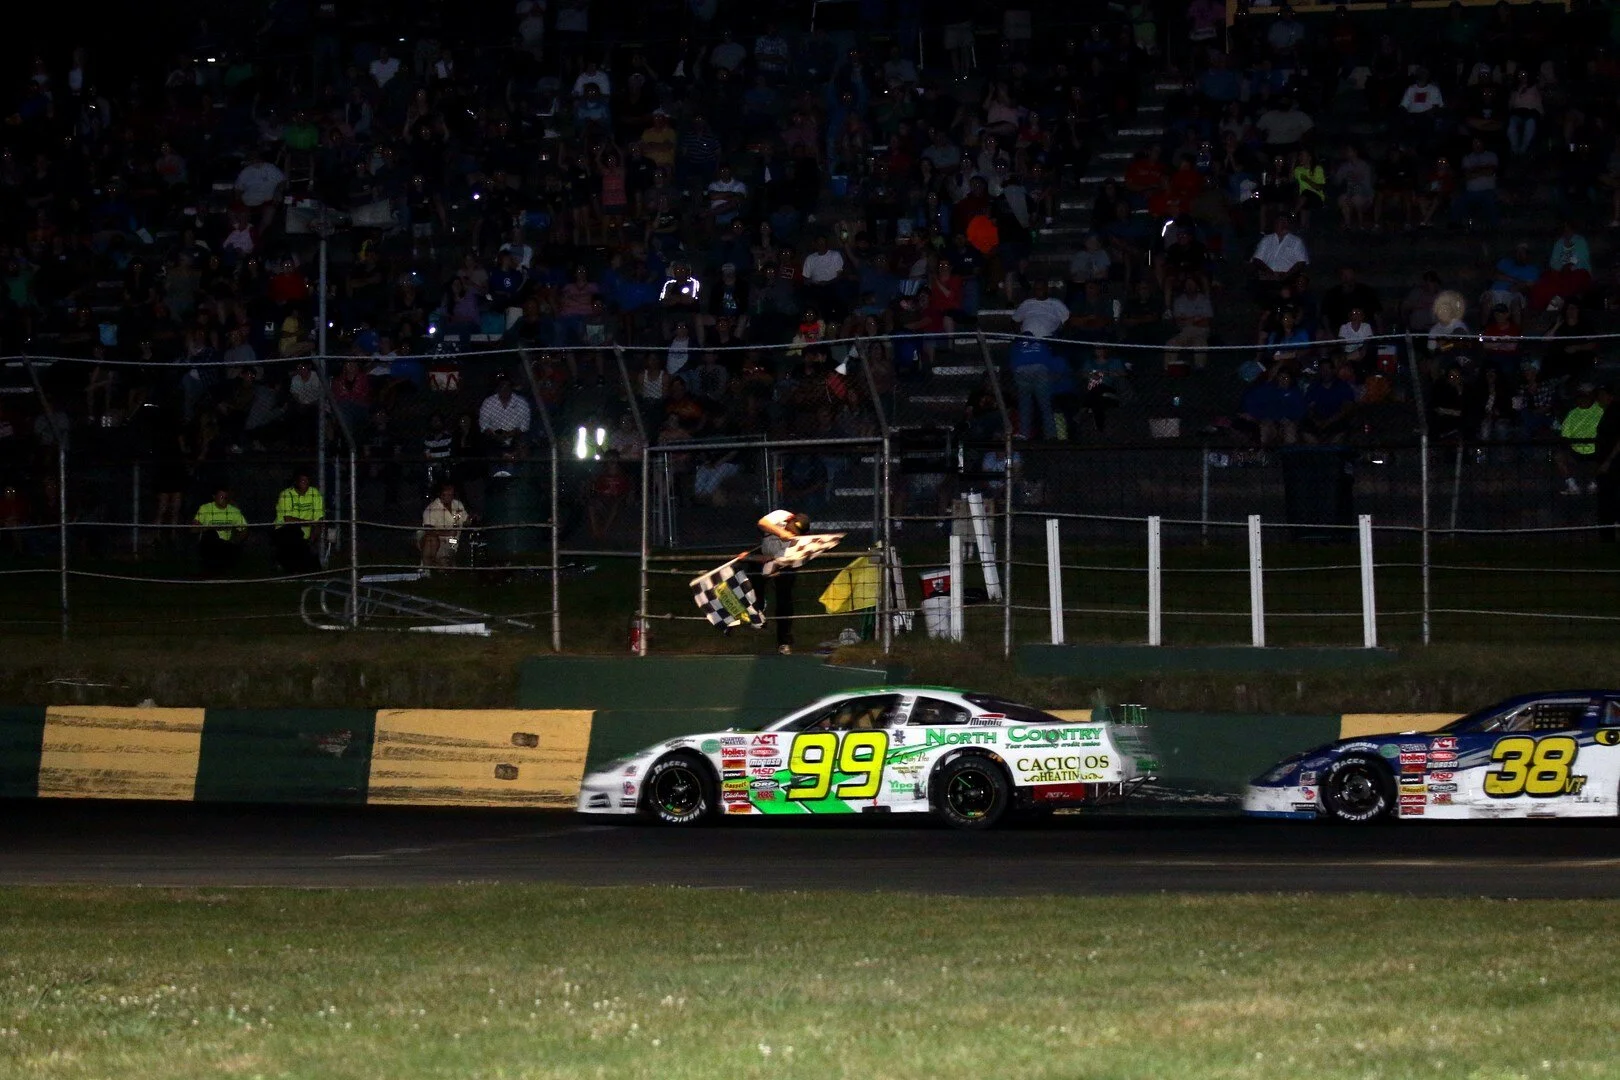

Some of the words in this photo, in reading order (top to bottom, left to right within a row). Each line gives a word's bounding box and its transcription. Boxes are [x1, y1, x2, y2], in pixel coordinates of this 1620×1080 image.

[751, 735, 779, 746] ACT
[926, 728, 998, 746] NORTH
[1430, 737, 1458, 749] ACT
[653, 760, 688, 775] RACER
[752, 767, 776, 775] MSD
[786, 730, 890, 802] 99
[1331, 758, 1366, 772] RACER
[1483, 735, 1579, 798] 38
